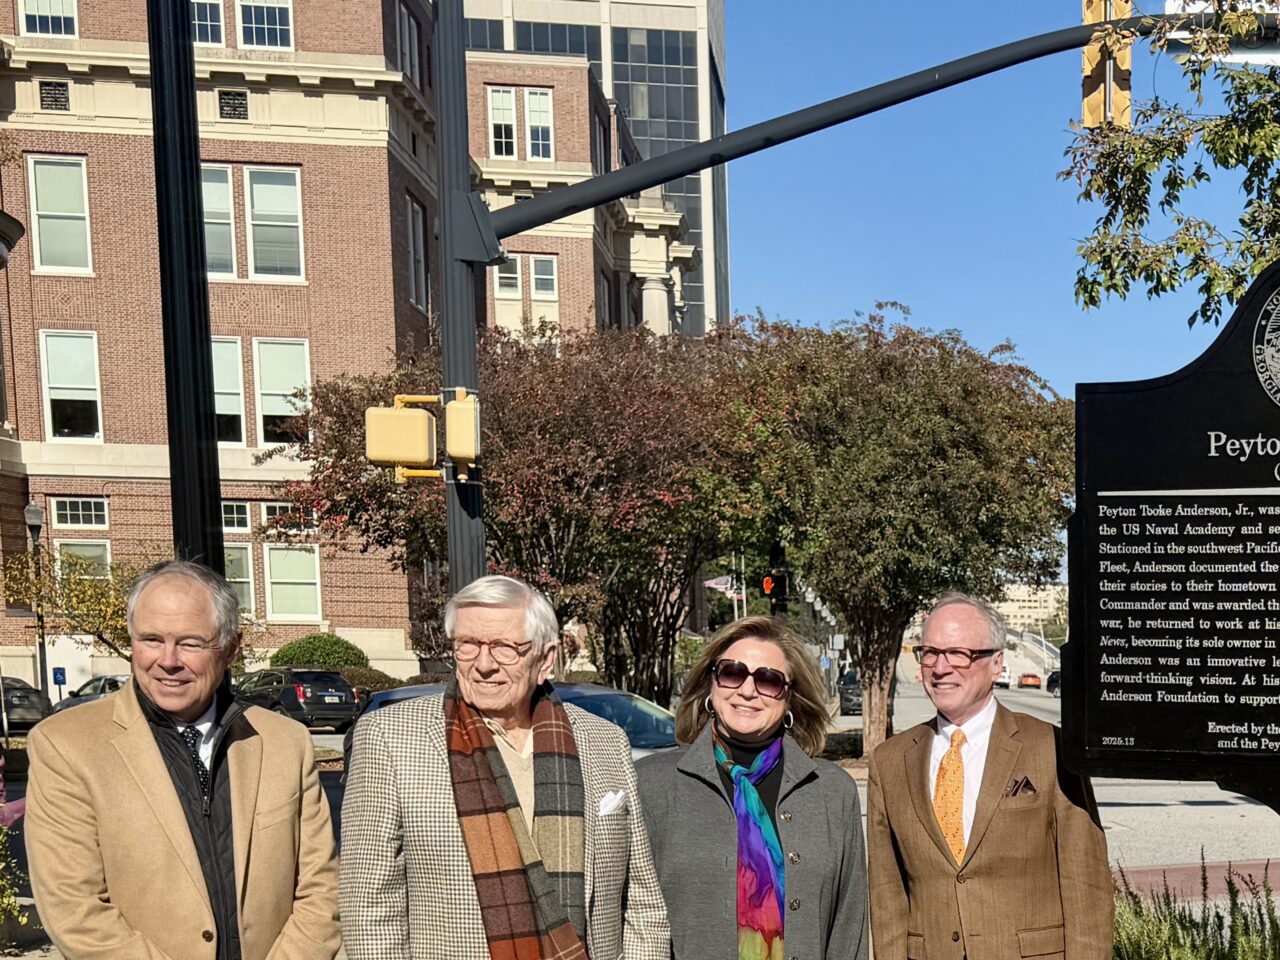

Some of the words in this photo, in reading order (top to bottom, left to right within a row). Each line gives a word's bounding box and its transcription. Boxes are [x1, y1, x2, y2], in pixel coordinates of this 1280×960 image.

[1098, 505, 1136, 518] Peyton
[1139, 504, 1172, 516] Tooke
[1174, 504, 1231, 517] Anderson,
[1235, 503, 1254, 517] Jr.,
[1258, 506, 1280, 515] was
[1098, 523, 1116, 535] the
[1122, 523, 1140, 535] US
[1145, 523, 1179, 535] Naval
[1183, 522, 1235, 537] Academy
[1240, 522, 1262, 534] and
[1098, 542, 1151, 553] Stationed
[1153, 542, 1165, 553] in
[1166, 542, 1185, 553] the
[1187, 542, 1244, 553] southwest
[1099, 560, 1130, 574] Fleet,
[1132, 560, 1186, 572] Anderson
[1188, 560, 1256, 572] documented
[1260, 560, 1279, 572] the
[1099, 579, 1126, 591] their
[1130, 579, 1167, 591] stories
[1170, 580, 1182, 591] to
[1186, 579, 1214, 591] their
[1217, 579, 1277, 591] hometown
[1099, 598, 1167, 610] Commander
[1168, 598, 1190, 610] and
[1192, 601, 1214, 610] was
[1216, 598, 1266, 610] awarded
[1099, 619, 1123, 629] war,
[1127, 616, 1141, 628] he
[1145, 617, 1194, 628] returned
[1199, 618, 1210, 629] to
[1215, 617, 1243, 629] work
[1247, 618, 1260, 629] at
[1099, 635, 1128, 648] News,
[1131, 635, 1182, 649] becoming
[1185, 635, 1200, 647] its
[1202, 636, 1224, 647] sole
[1226, 639, 1262, 648] owner
[1264, 636, 1276, 648] in
[1099, 653, 1151, 665] Anderson
[1158, 657, 1180, 665] was
[1186, 657, 1200, 666] an
[1207, 654, 1266, 667] innovative
[1100, 671, 1193, 686] forward-thinking
[1199, 673, 1236, 685] vision.
[1241, 673, 1256, 685] At
[1262, 674, 1280, 686] his
[1100, 689, 1152, 701] Anderson
[1156, 690, 1219, 703] Foundation
[1223, 693, 1235, 703] to
[1208, 722, 1248, 734] Erected
[1251, 723, 1264, 736] by
[1217, 737, 1239, 749] and
[1240, 738, 1258, 749] the
